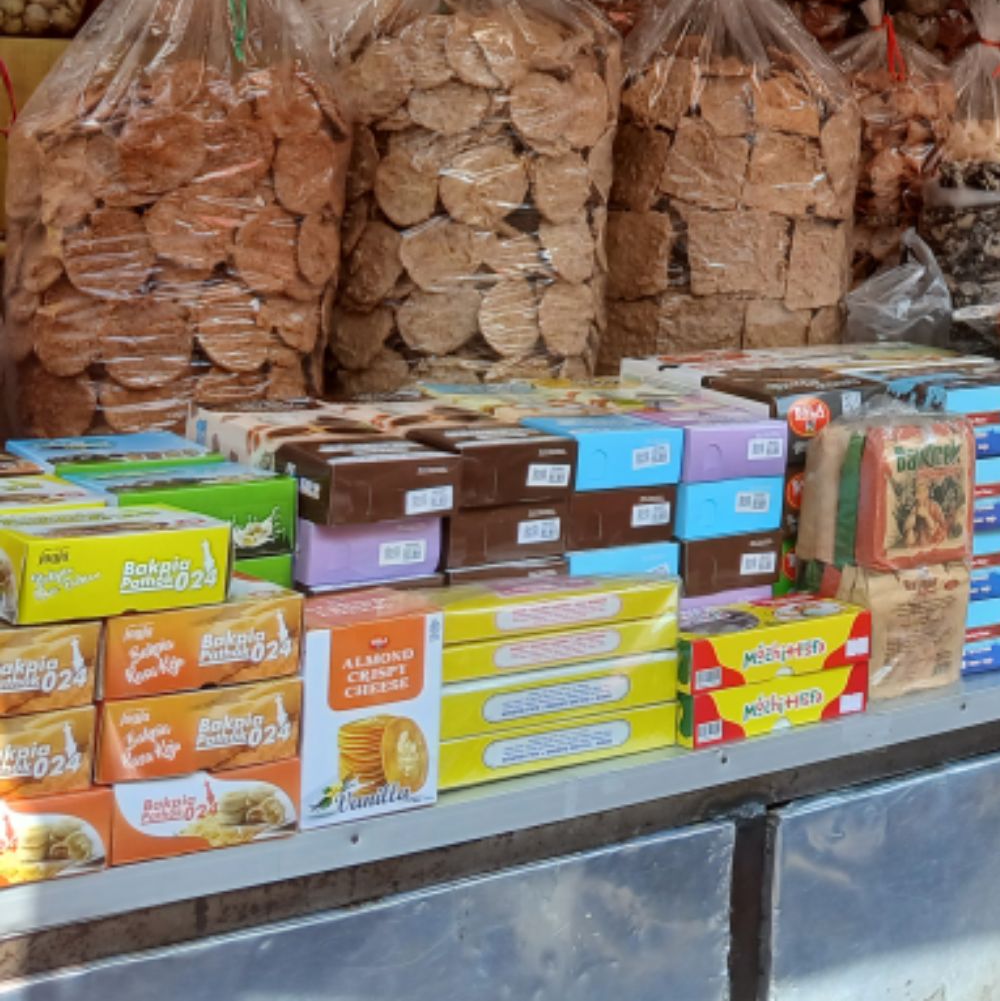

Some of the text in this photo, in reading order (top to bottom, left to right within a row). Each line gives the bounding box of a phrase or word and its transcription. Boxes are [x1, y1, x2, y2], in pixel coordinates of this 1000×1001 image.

[124, 557, 191, 580] Bakpia
[174, 567, 218, 591] 024
[203, 628, 266, 653] Bakpia
[251, 638, 293, 663] 024
[0, 657, 59, 678] akpia
[343, 648, 415, 670] ALMOND
[41, 668, 88, 693] 024
[347, 664, 408, 684] CRISPY
[344, 677, 410, 698] CHEESE
[199, 713, 264, 738] Bakpia
[249, 722, 292, 748] 024
[33, 752, 83, 779] 024
[142, 795, 197, 817] Bakpia
[338, 780, 412, 813] Vanilla
[184, 802, 219, 823] 024
